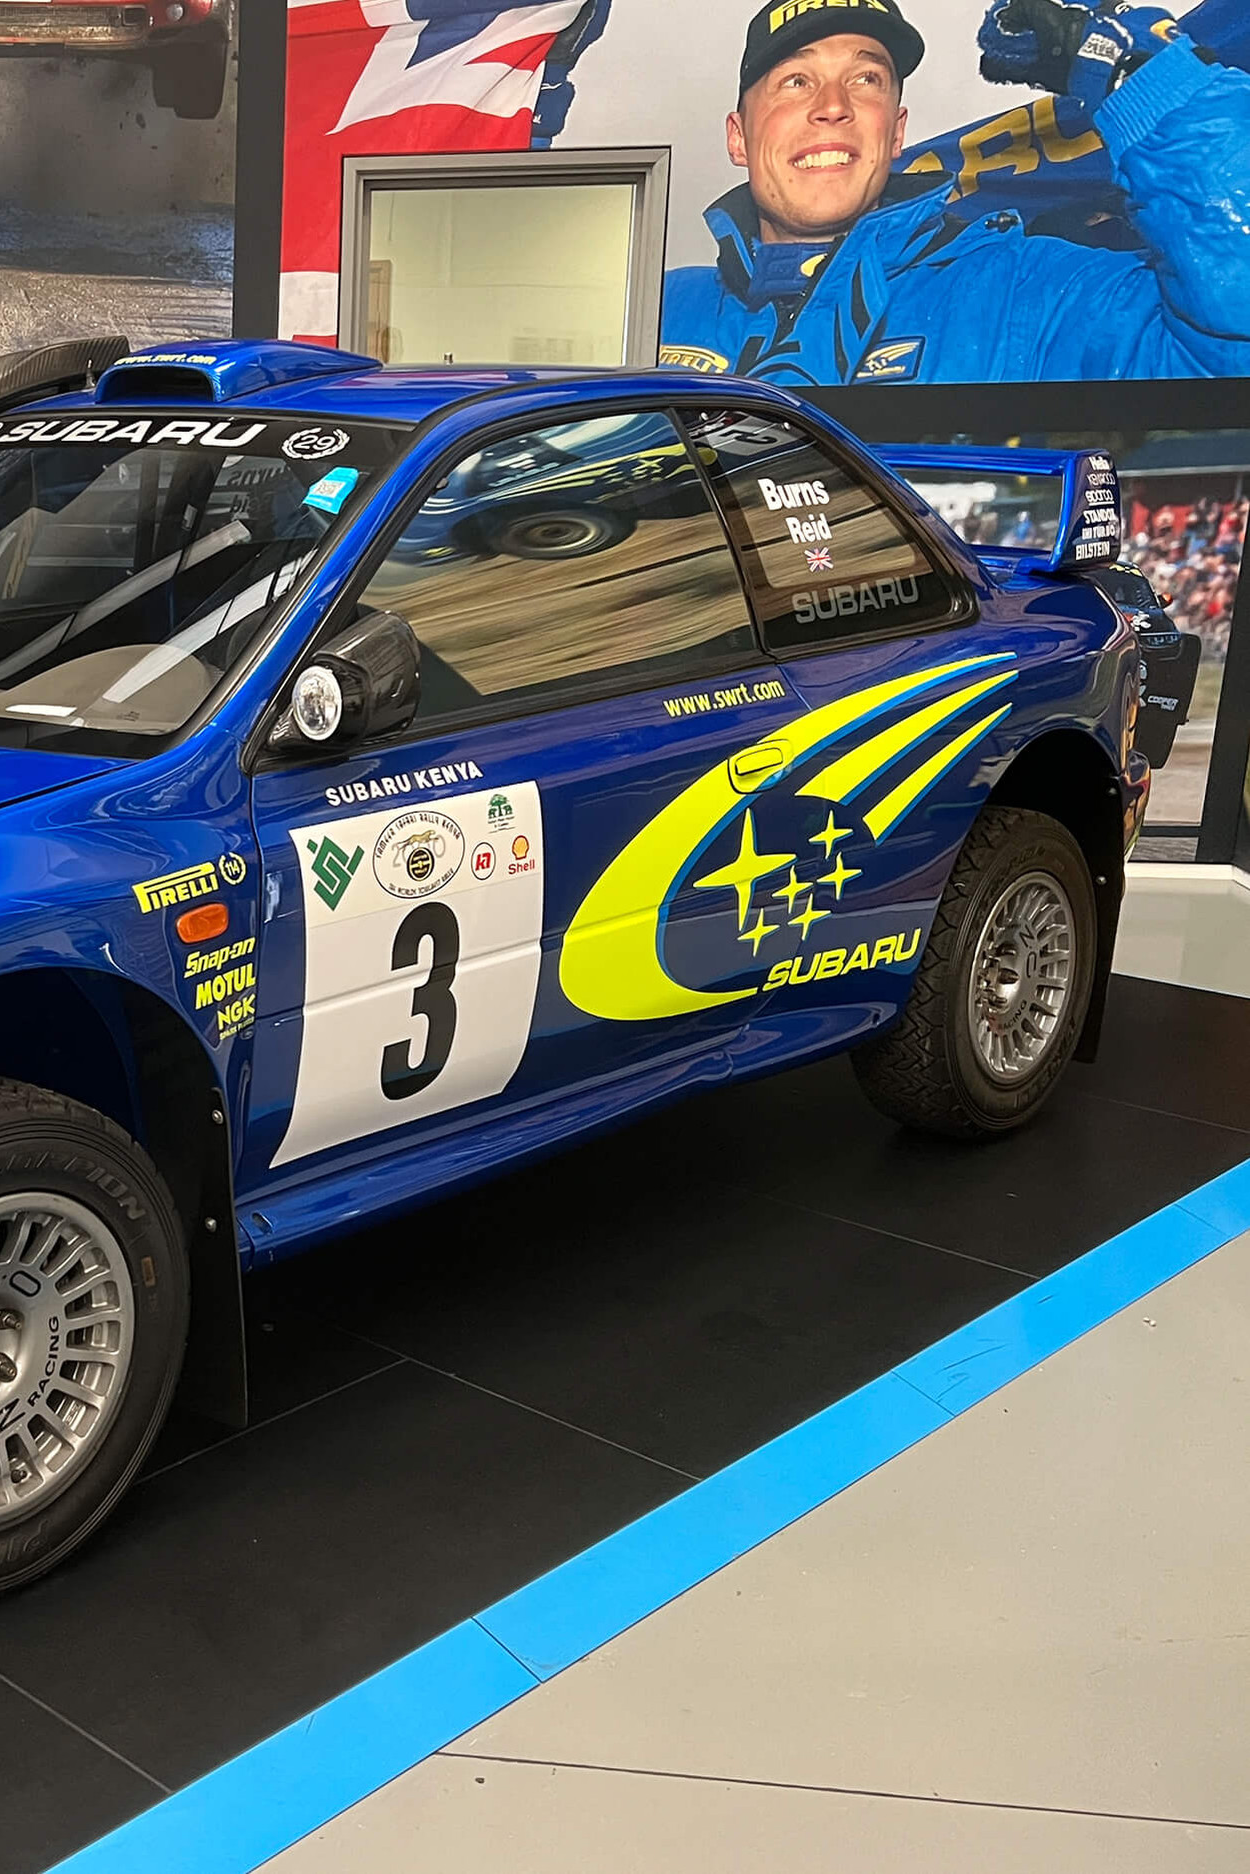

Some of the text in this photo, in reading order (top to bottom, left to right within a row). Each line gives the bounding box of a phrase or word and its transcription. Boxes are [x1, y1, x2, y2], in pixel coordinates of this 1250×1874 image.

[294, 434, 335, 451] 29
[758, 478, 830, 511] Burns
[785, 513, 832, 545] Reid
[1075, 540, 1110, 561] BILSTEIN
[792, 573, 919, 624] SUBARU
[663, 680, 785, 717] www.swrt.com
[325, 761, 484, 807] SUBARU KENYA
[132, 861, 220, 914] PIRELLI
[508, 859, 536, 875] Shell
[184, 937, 256, 978] Snap-on
[762, 928, 922, 992] SUBARU
[195, 963, 256, 1010] MOTUL
[379, 901, 461, 1101] 3
[217, 993, 256, 1030] NGK
[27, 1316, 59, 1407] RACING
